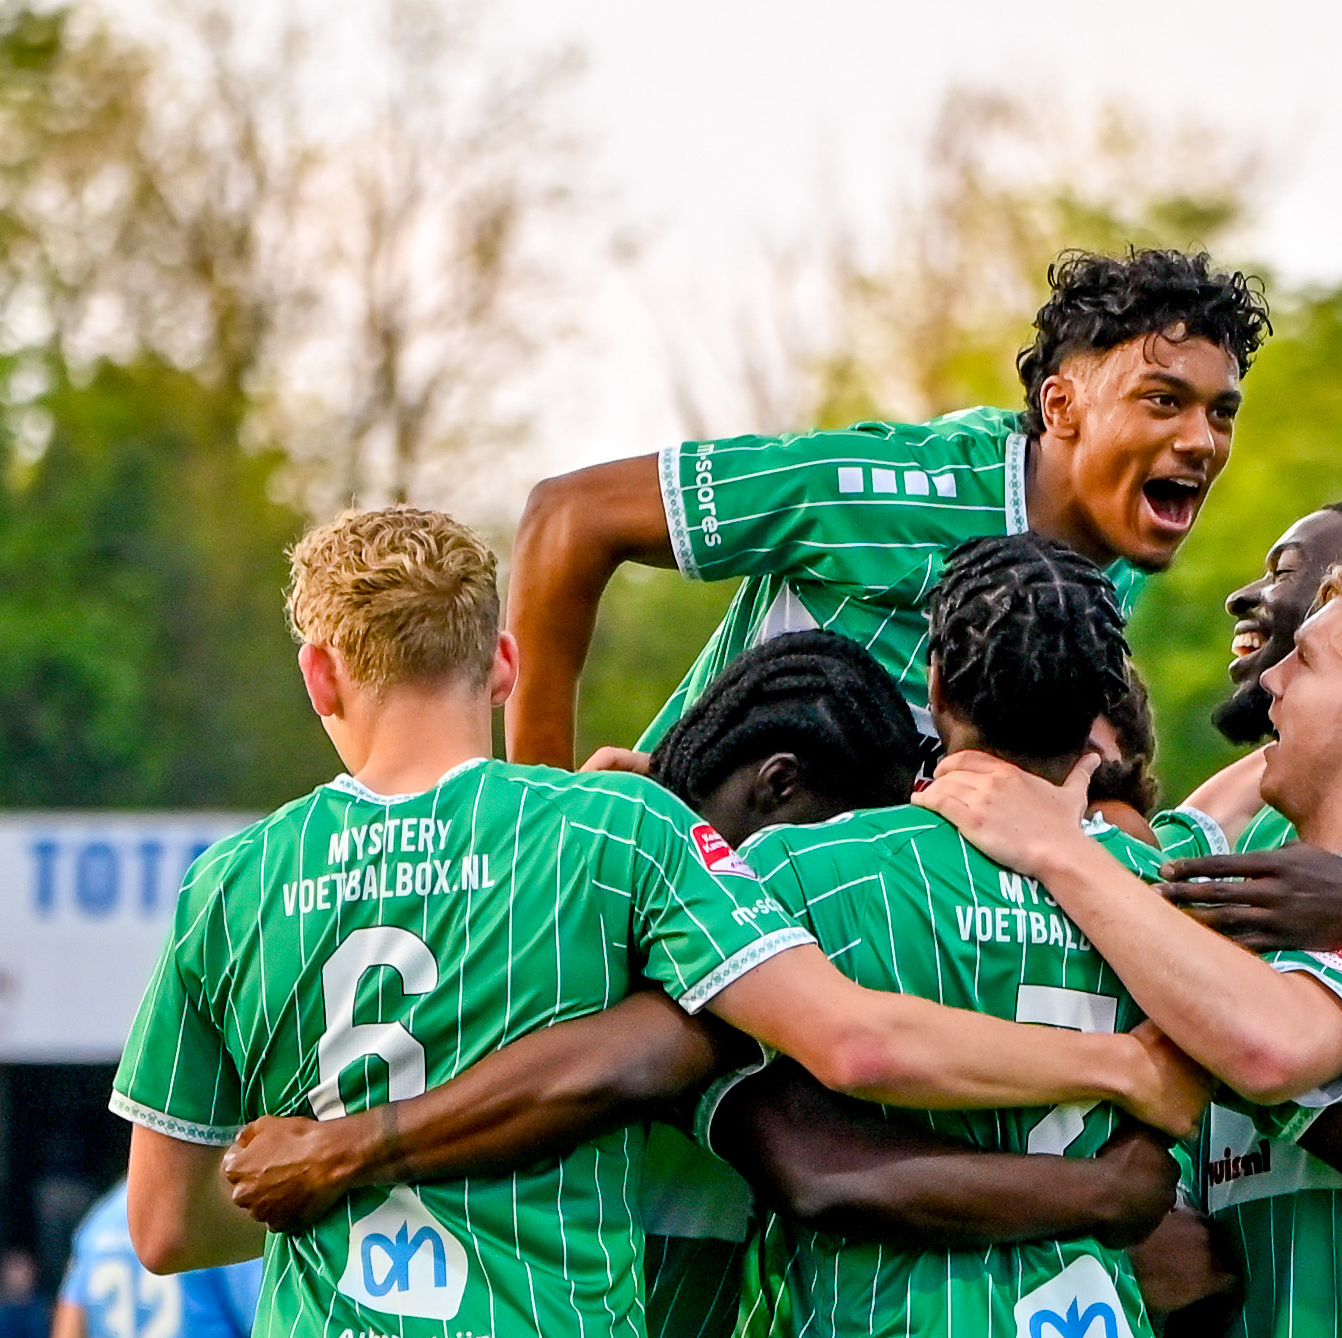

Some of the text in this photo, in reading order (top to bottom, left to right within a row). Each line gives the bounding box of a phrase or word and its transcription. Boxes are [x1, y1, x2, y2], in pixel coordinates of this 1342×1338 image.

[327, 817, 453, 866] MYSTERY
[282, 853, 496, 917] VOETBALBOX.NL
[307, 924, 440, 1121] 6
